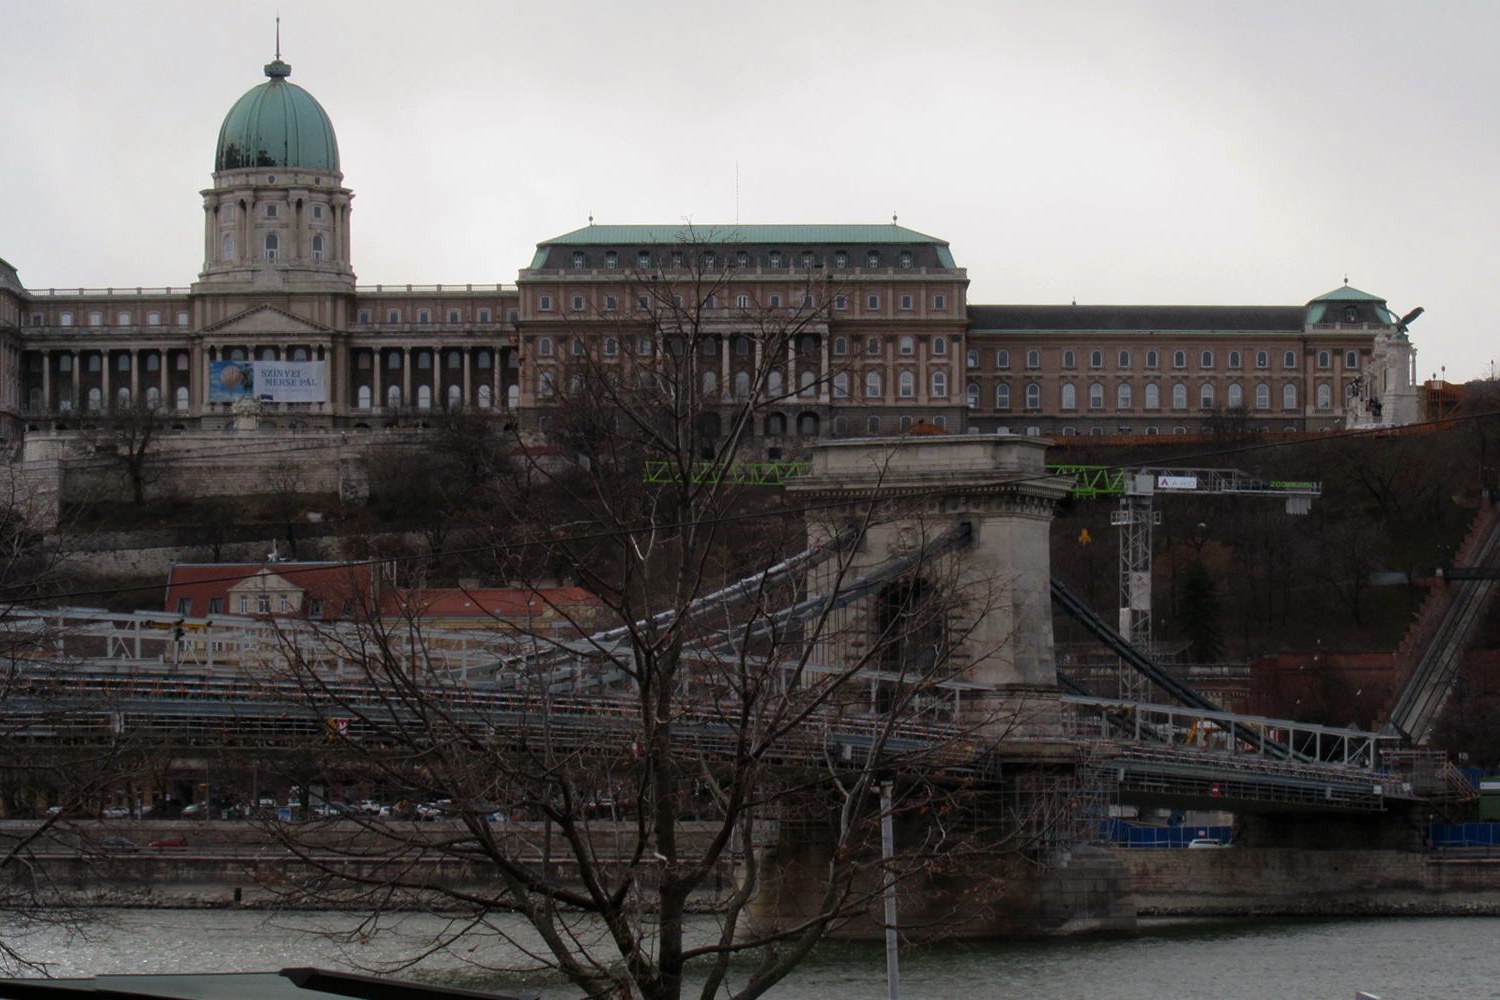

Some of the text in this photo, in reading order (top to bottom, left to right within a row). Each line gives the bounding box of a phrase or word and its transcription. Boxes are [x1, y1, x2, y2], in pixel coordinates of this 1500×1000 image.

[261, 369, 301, 378] SZINYEI
[265, 376, 318, 387] MERSE PÁL
